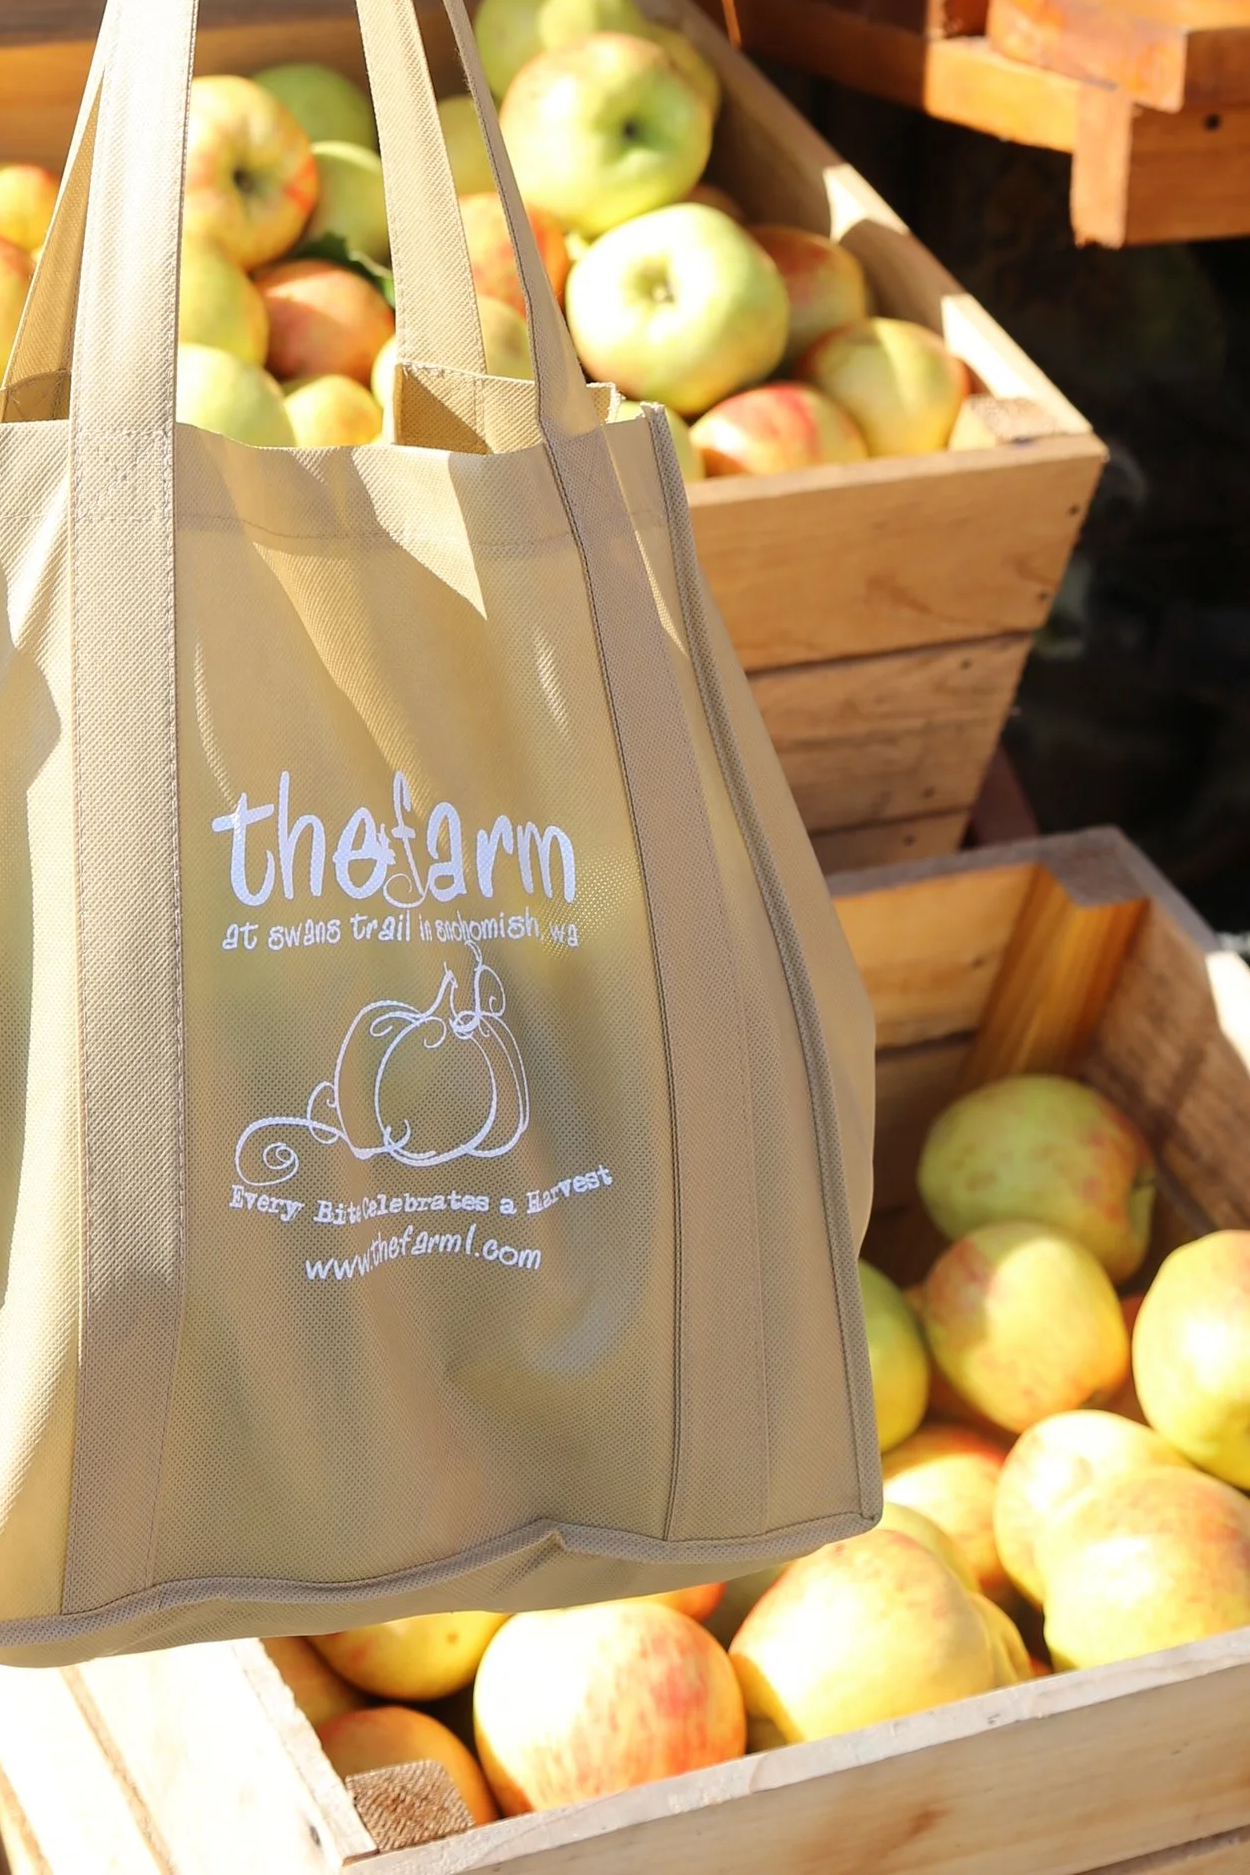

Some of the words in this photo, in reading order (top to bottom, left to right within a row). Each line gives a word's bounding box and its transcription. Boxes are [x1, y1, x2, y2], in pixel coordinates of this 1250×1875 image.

[222, 923, 259, 951] at
[267, 918, 341, 951] swans
[350, 910, 410, 943] trail
[418, 913, 432, 942] in
[551, 923, 579, 947] wa
[229, 1183, 305, 1222] Every
[361, 1190, 489, 1221] Celebrates
[499, 1195, 517, 1215] a
[526, 1164, 613, 1215] Harvest
